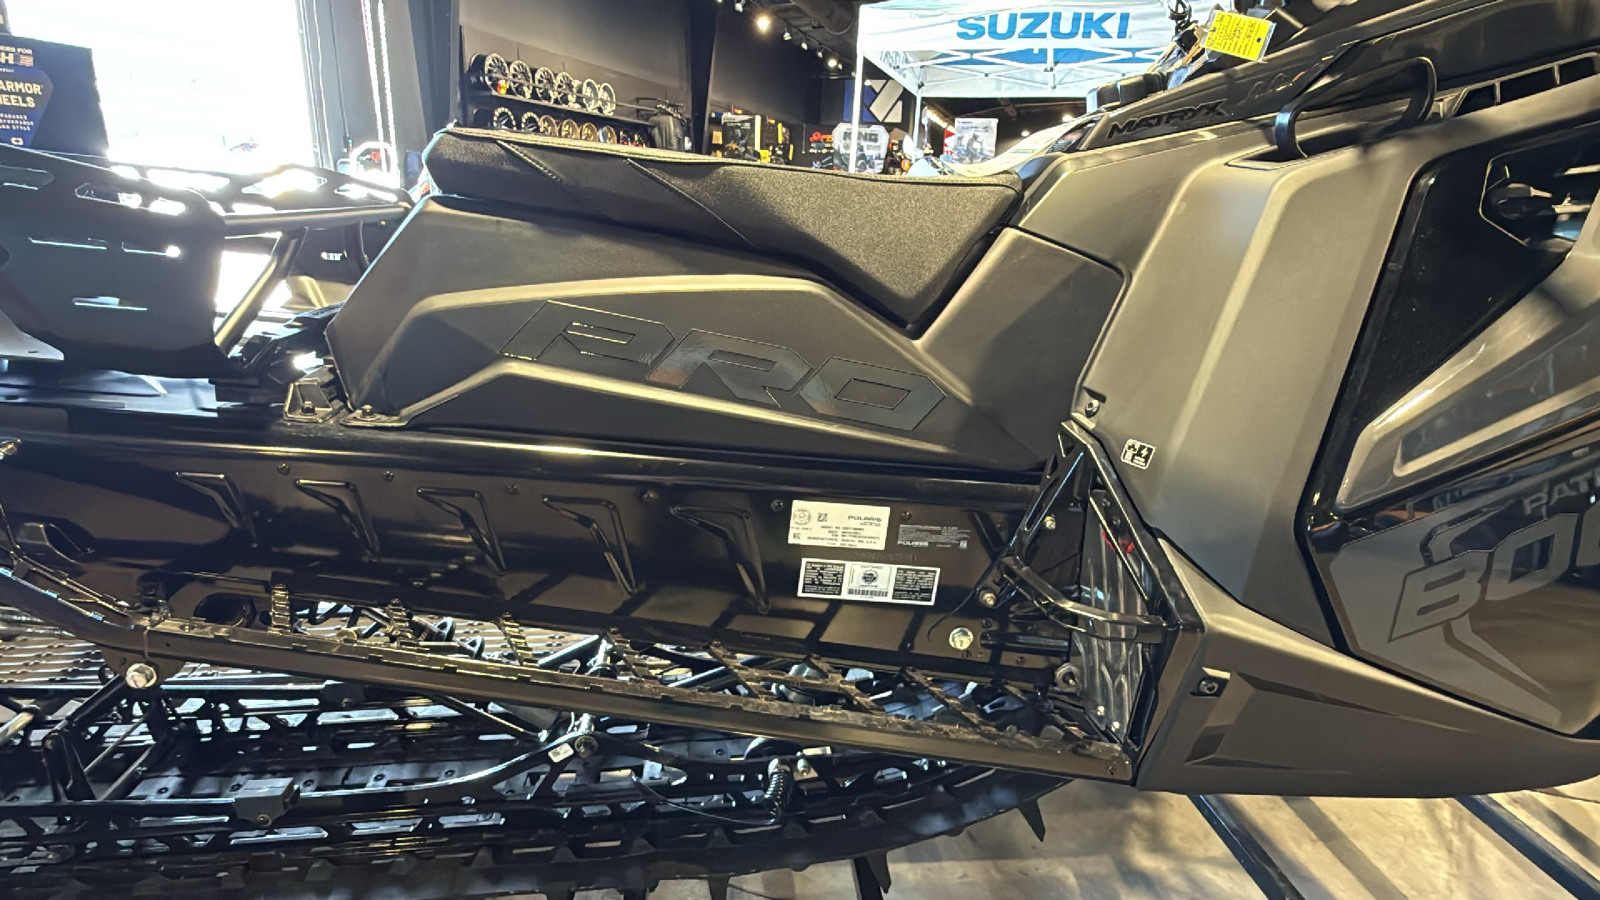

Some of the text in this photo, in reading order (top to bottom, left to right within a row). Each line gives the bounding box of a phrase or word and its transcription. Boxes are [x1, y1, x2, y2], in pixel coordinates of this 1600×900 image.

[956, 12, 1130, 40] SUZUKI
[17, 47, 33, 55] FOR
[0, 79, 43, 95] ARMOR
[1106, 99, 1229, 140] MATRYX
[843, 131, 879, 144] KNG
[499, 299, 947, 432] PRO
[848, 514, 882, 523] POLARIS
